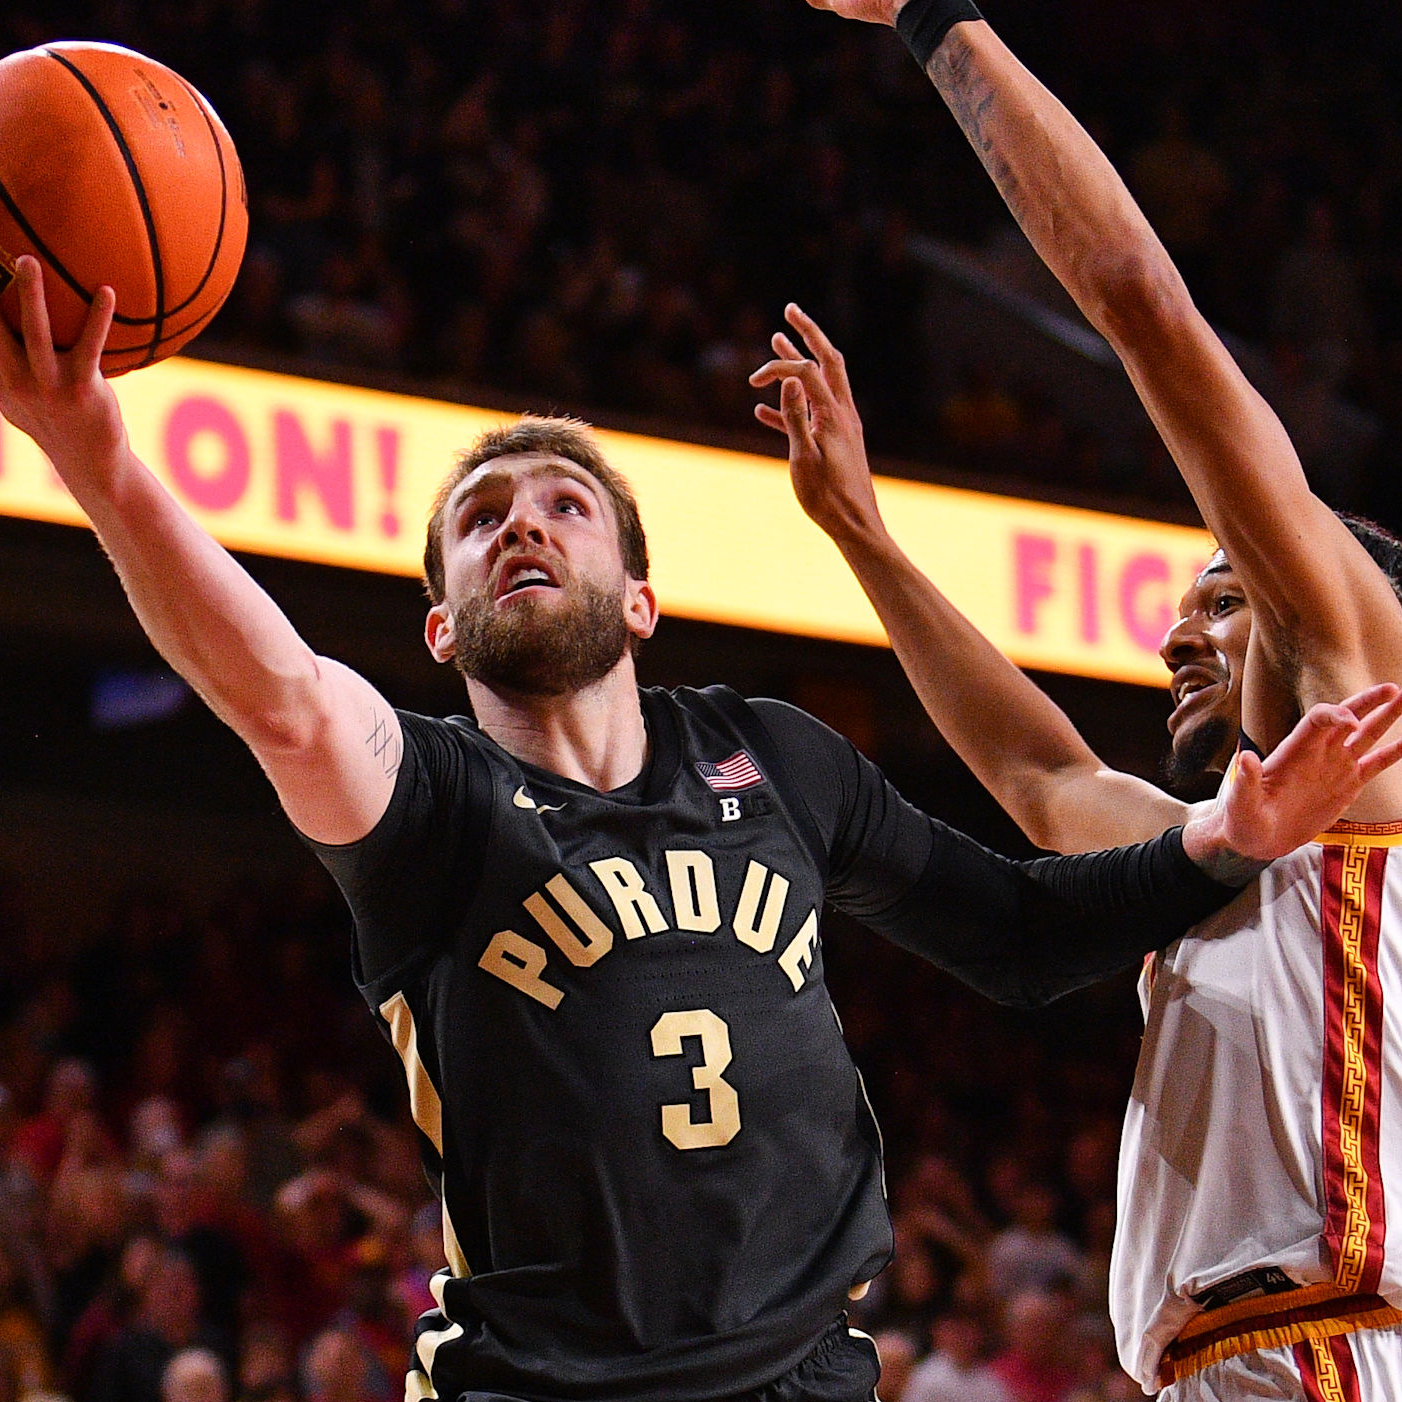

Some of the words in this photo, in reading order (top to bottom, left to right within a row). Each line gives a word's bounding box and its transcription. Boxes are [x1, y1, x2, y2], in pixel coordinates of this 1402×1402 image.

[164, 394, 399, 538] ON!
[1014, 534, 1182, 652] FIG
[478, 850, 821, 1010] PURDUE
[650, 1009, 741, 1150] 3
